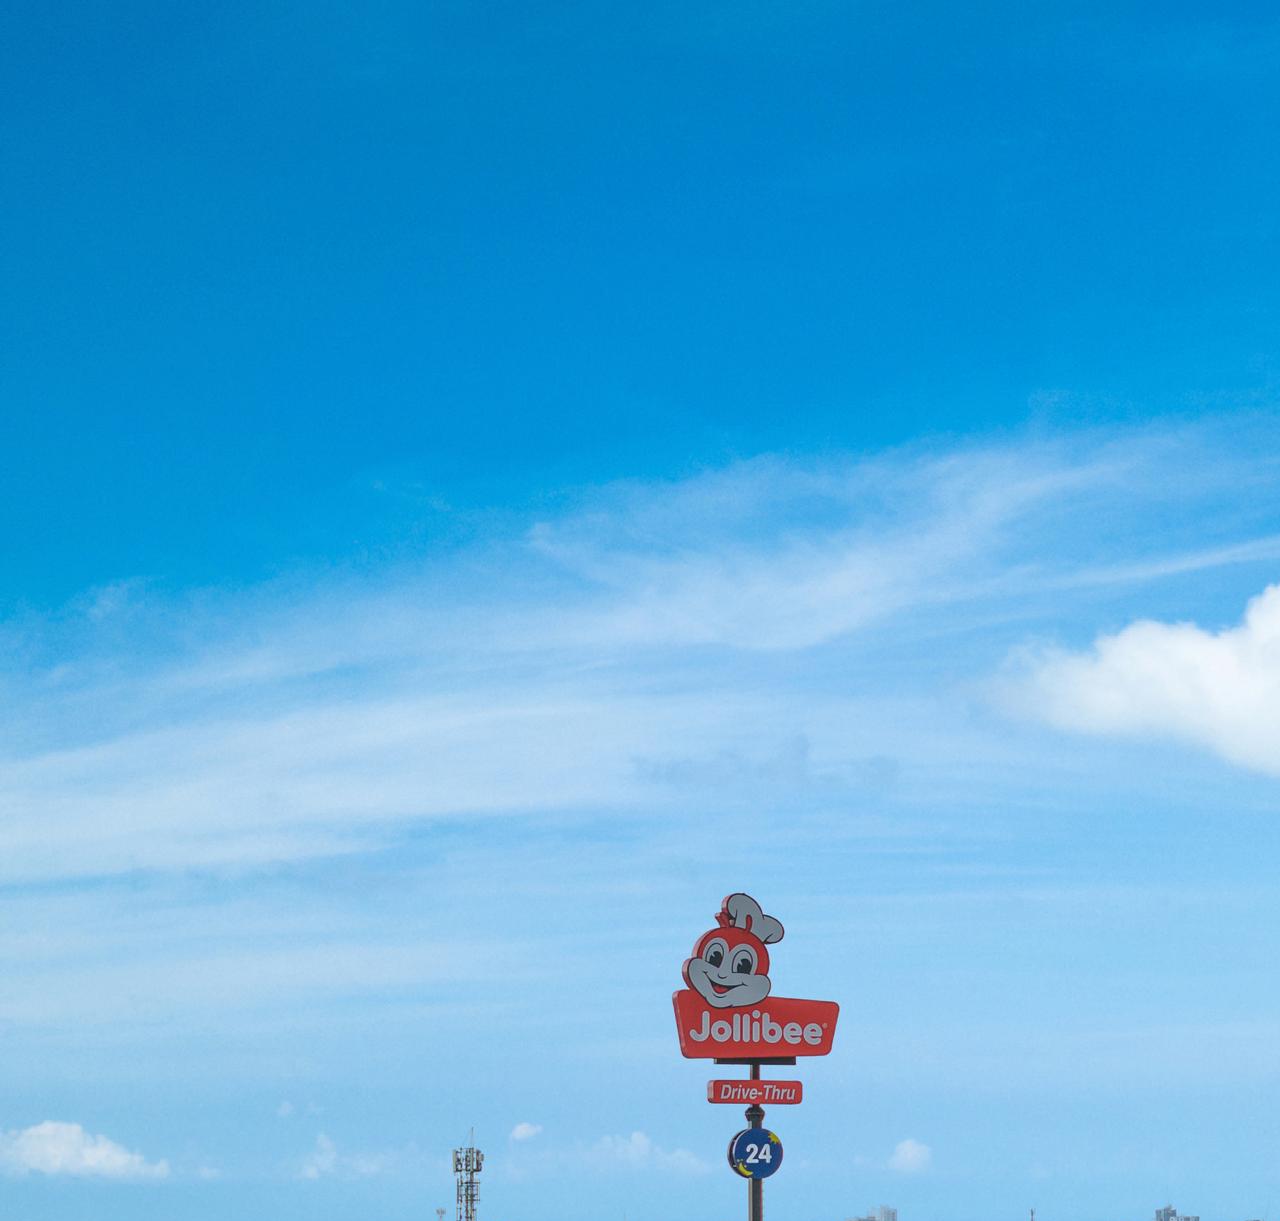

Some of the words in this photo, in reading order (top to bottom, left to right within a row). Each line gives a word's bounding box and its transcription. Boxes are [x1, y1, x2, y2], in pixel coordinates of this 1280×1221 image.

[689, 1010, 823, 1046] Jollibee
[720, 1083, 796, 1101] Drive-Thru
[745, 1143, 772, 1164] 24
